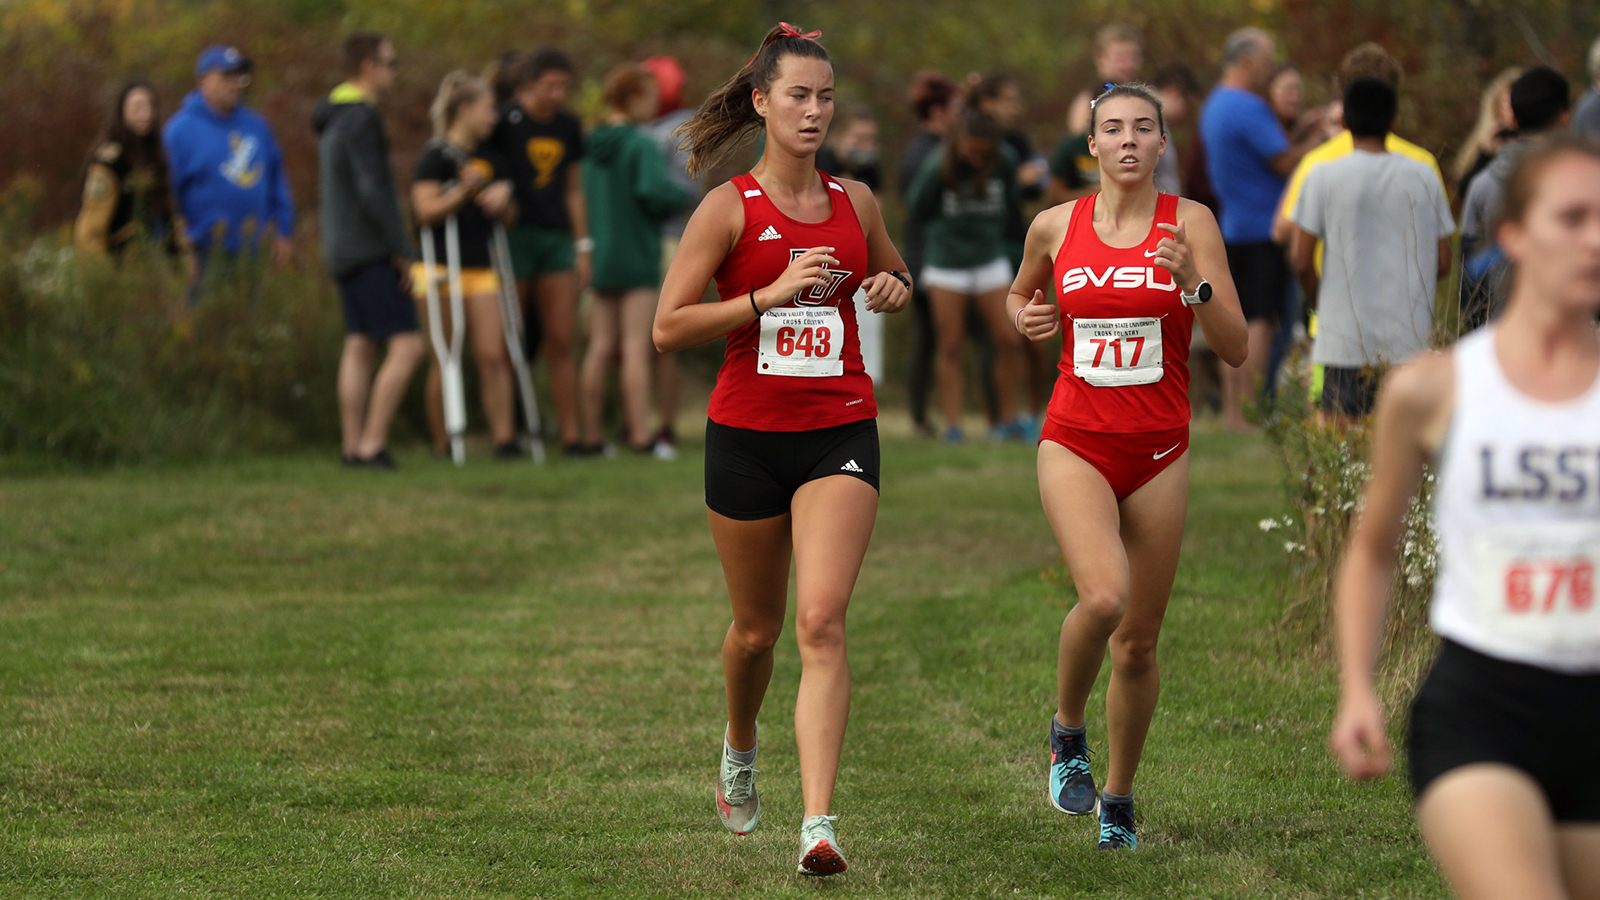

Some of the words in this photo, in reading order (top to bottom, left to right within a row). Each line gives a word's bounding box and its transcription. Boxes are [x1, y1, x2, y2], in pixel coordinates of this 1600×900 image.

[758, 233, 782, 241] adidas
[1129, 320, 1155, 328] UNIVERSITY
[776, 326, 831, 357] 643
[1089, 336, 1145, 368] 717
[1480, 445, 1600, 500] LSS
[1504, 558, 1595, 615] 676
